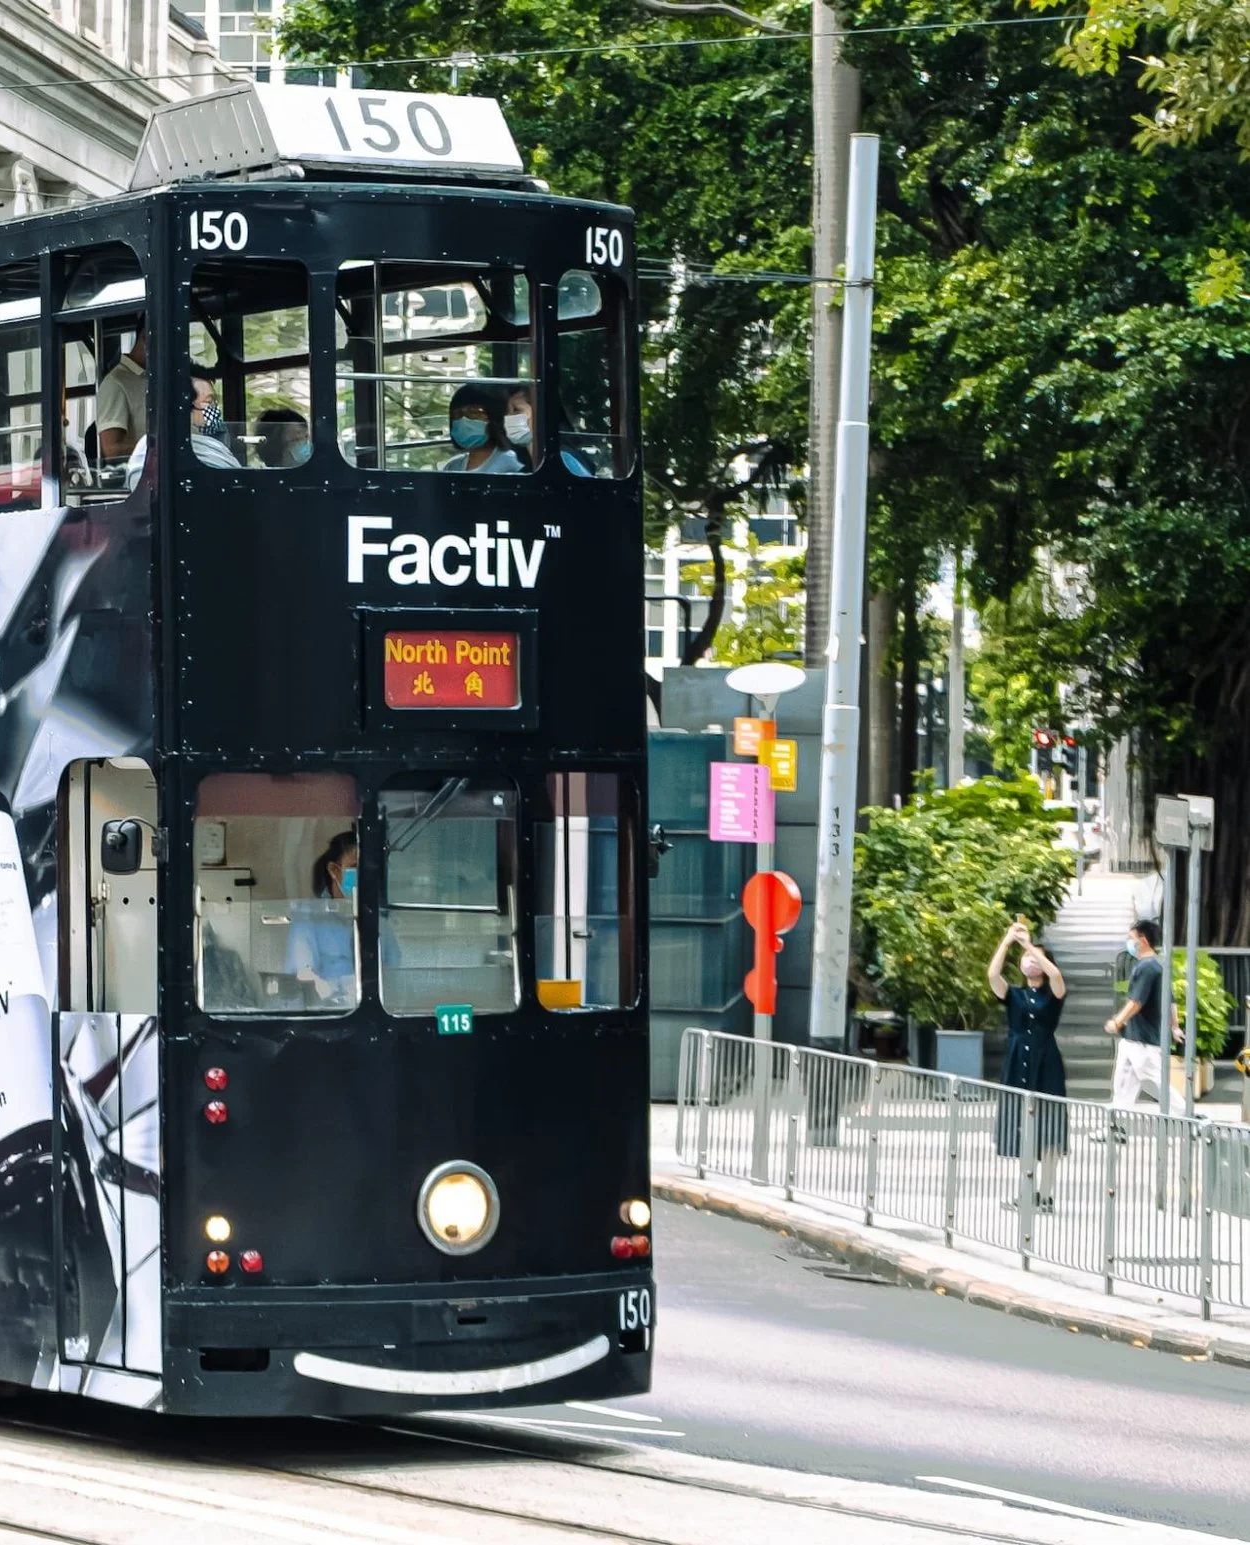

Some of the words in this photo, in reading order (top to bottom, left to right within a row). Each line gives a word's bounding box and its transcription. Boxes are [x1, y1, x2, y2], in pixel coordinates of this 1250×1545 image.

[325, 96, 453, 156] 150
[189, 210, 249, 251] 150
[586, 227, 624, 268] 150
[384, 638, 448, 665] North
[455, 640, 511, 666] Point
[440, 1013, 471, 1032] 115
[619, 1288, 651, 1331] 150
